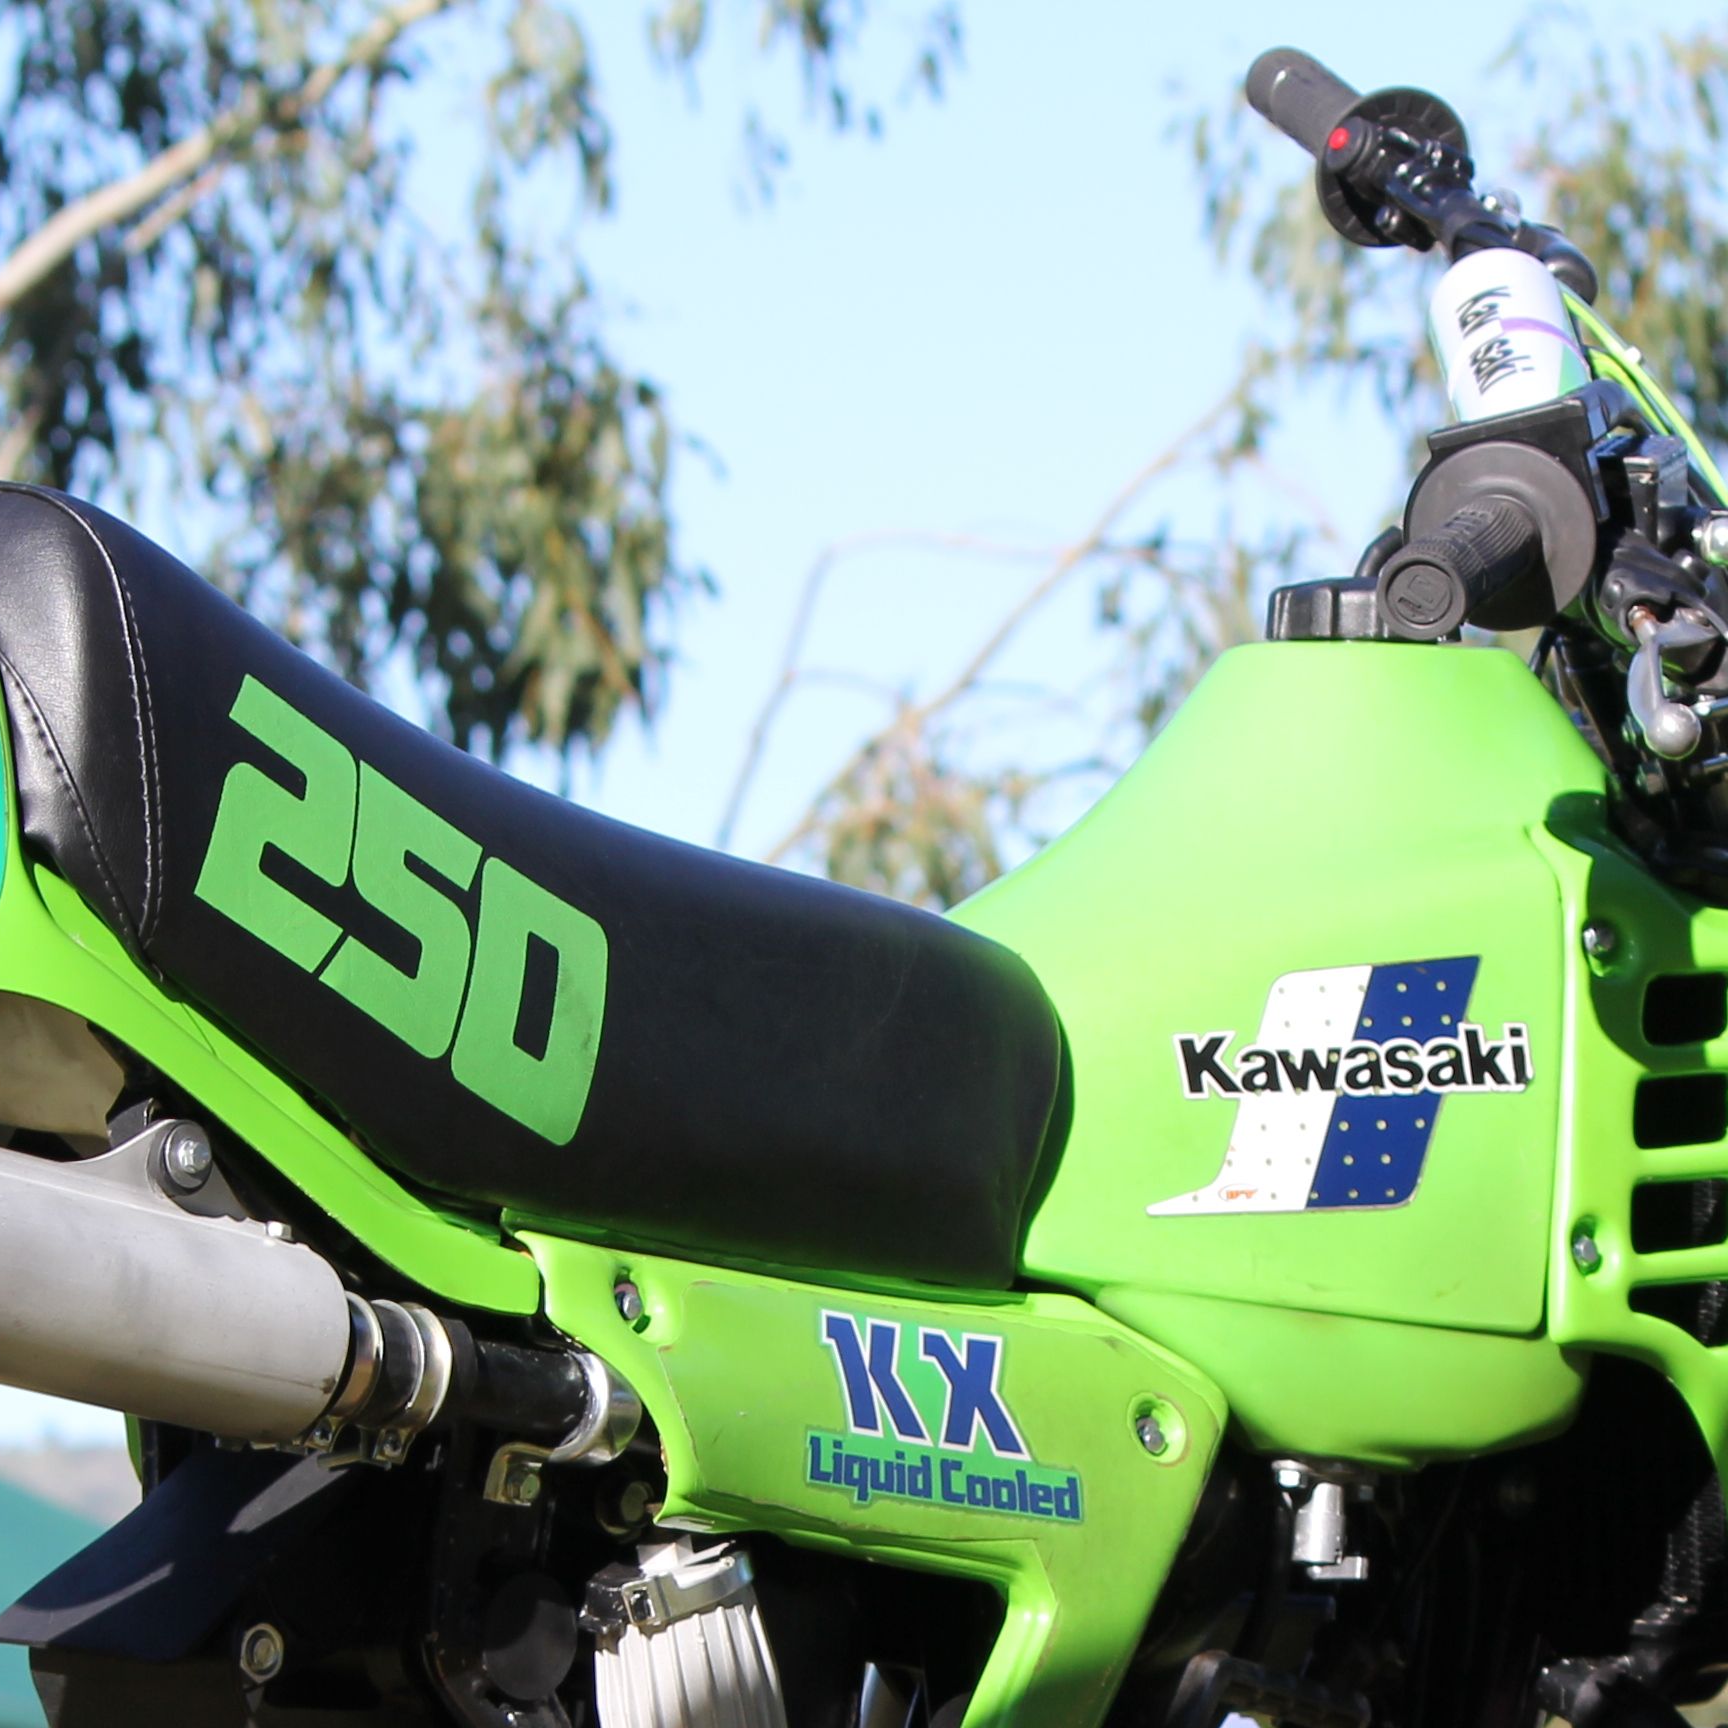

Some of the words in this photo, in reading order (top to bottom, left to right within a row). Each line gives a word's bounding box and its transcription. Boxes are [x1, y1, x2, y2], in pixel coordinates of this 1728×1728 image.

[194, 672, 610, 1147] 250
[1175, 1022, 1533, 1097] Kawasaki
[821, 1308, 1032, 1461] KX
[808, 1435, 934, 1503] Liquid
[940, 1458, 1082, 1520] Cooled
